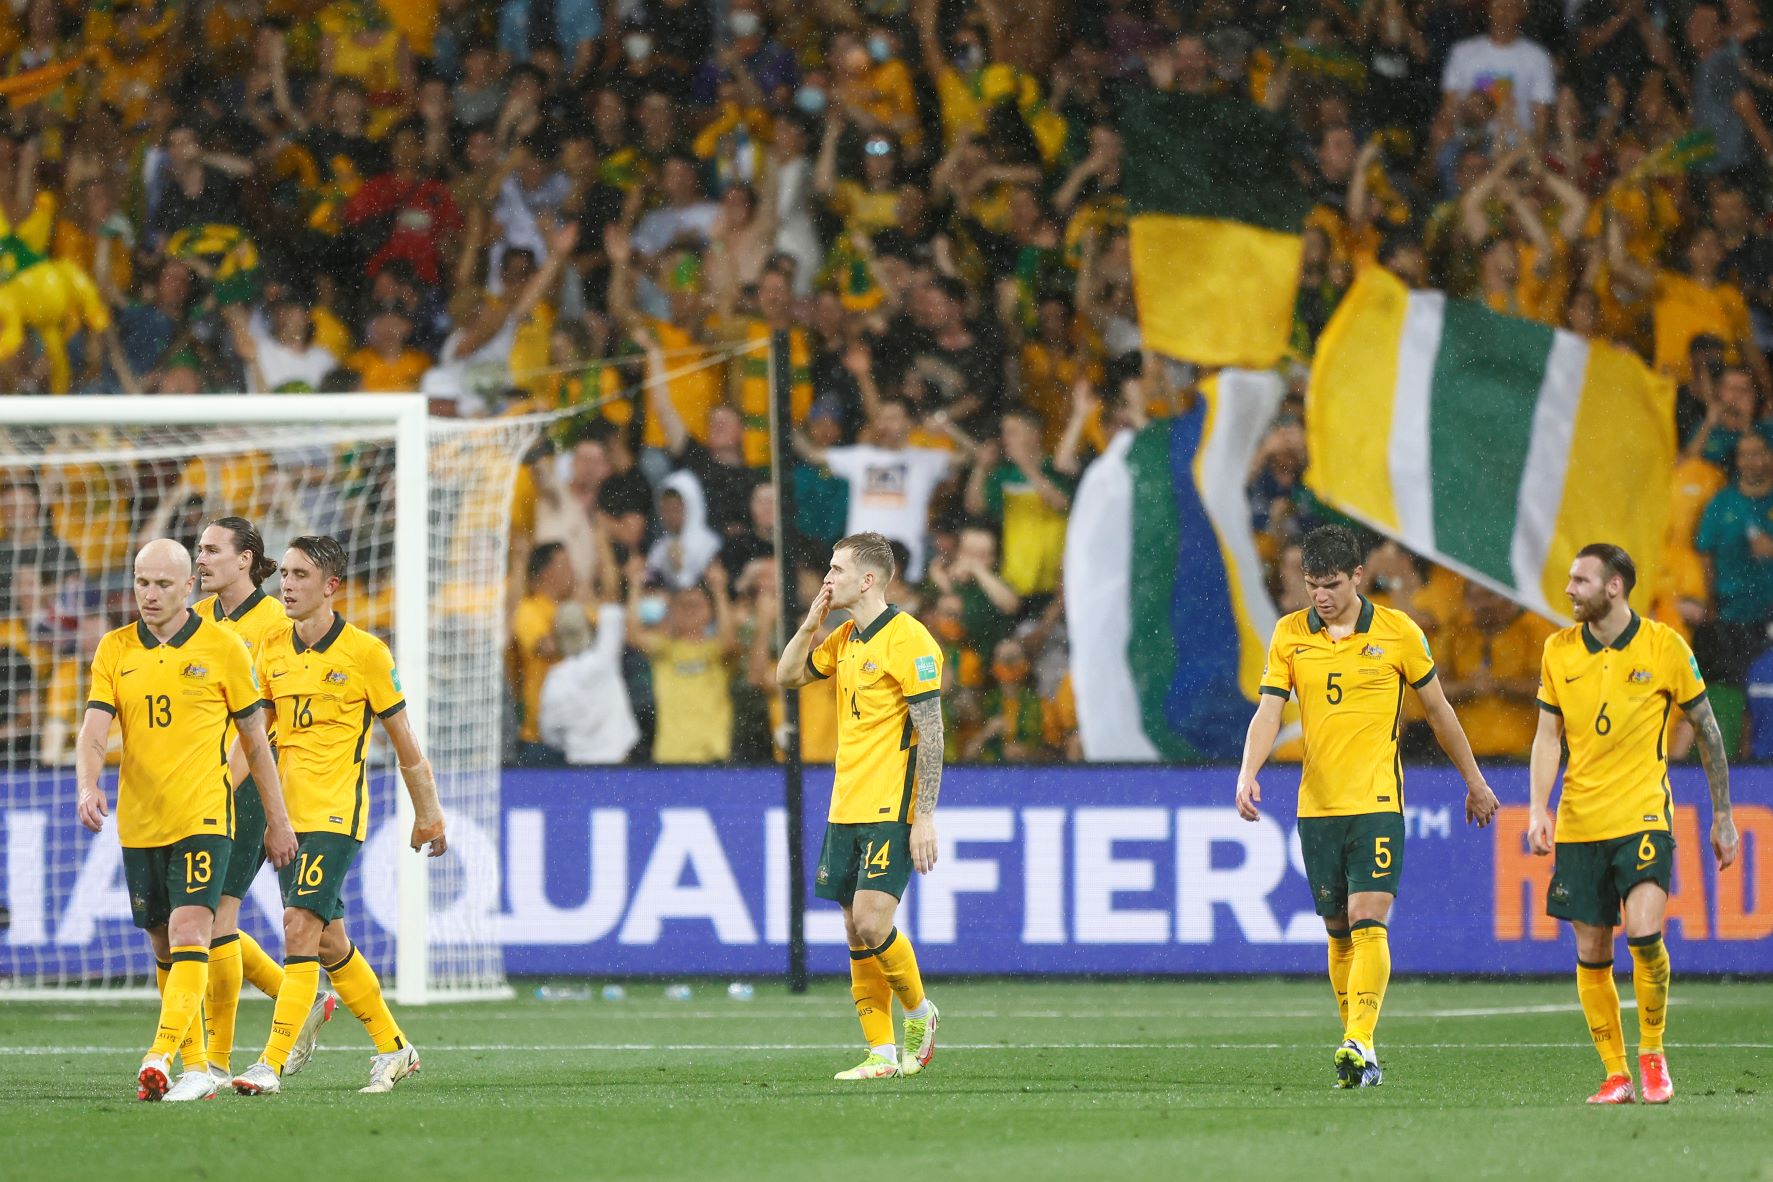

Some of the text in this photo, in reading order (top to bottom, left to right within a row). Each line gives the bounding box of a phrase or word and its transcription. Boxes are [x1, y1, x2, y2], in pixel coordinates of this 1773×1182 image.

[1326, 672, 1343, 706] 5
[145, 694, 172, 728] 13
[292, 694, 313, 728] 16
[1595, 702, 1611, 736] 6
[863, 839, 890, 870] 14
[1374, 837, 1392, 869] 5
[1637, 833, 1656, 861] 6
[183, 851, 212, 884] 13
[297, 853, 324, 887] 16
[1358, 998, 1377, 1010] AUS
[272, 1025, 292, 1038] AUS
